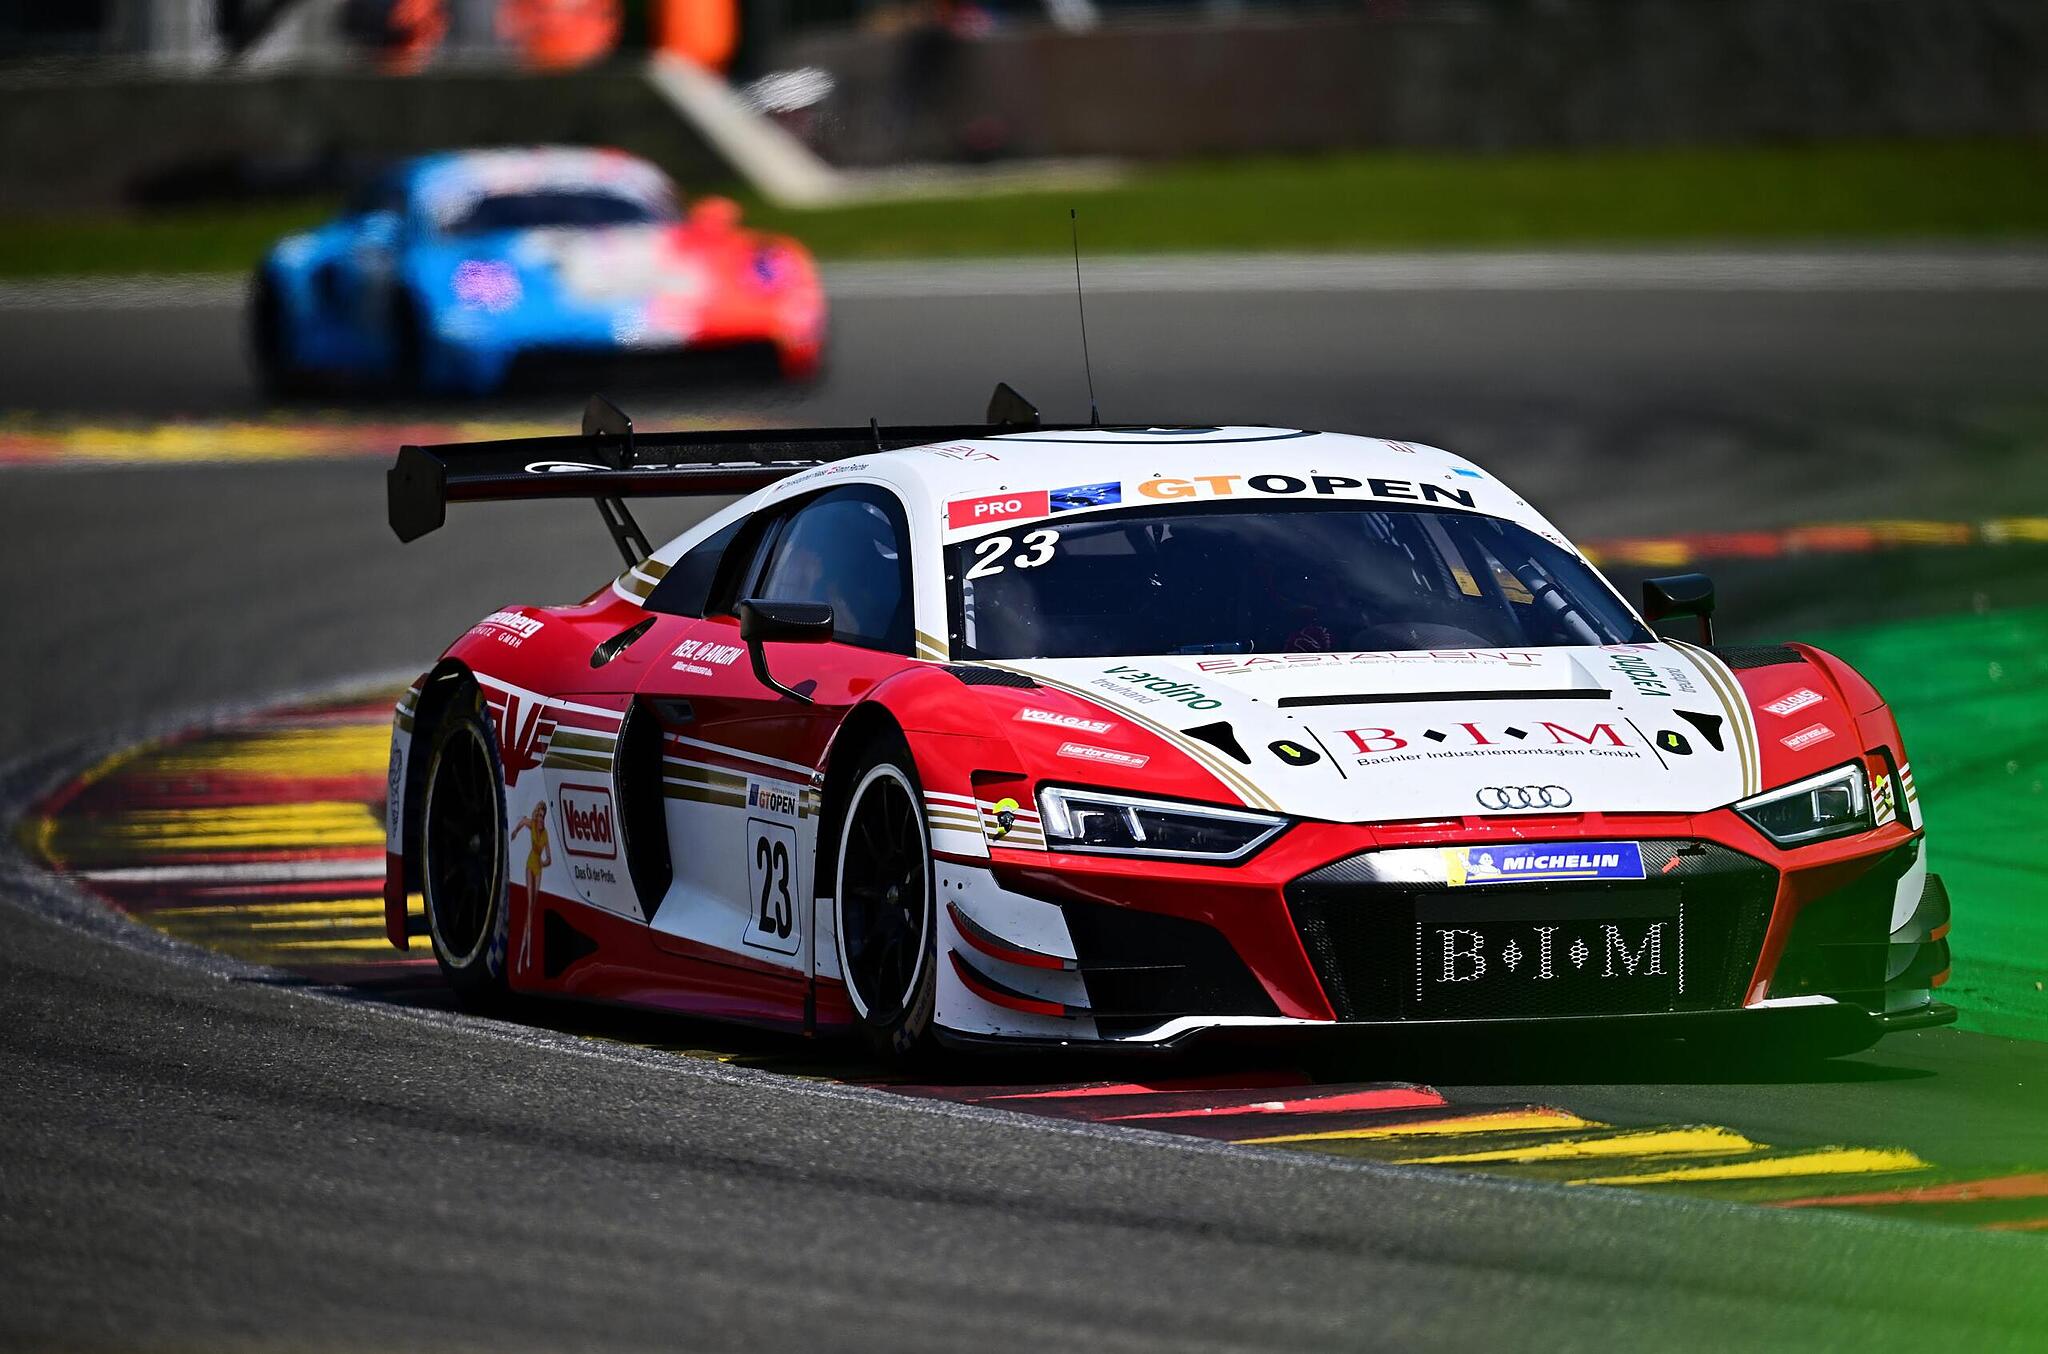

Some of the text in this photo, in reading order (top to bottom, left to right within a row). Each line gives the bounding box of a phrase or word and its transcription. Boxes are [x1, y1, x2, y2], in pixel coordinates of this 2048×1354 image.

[974, 499, 1022, 518] PRO
[966, 530, 1059, 580] 23
[1197, 651, 1542, 671] EASTALENT
[1356, 748, 1641, 766] Bachler Industriemontagen GmbH
[562, 800, 612, 844] Veedol
[1502, 854, 1619, 870] MICHELIN
[757, 836, 792, 939] 23
